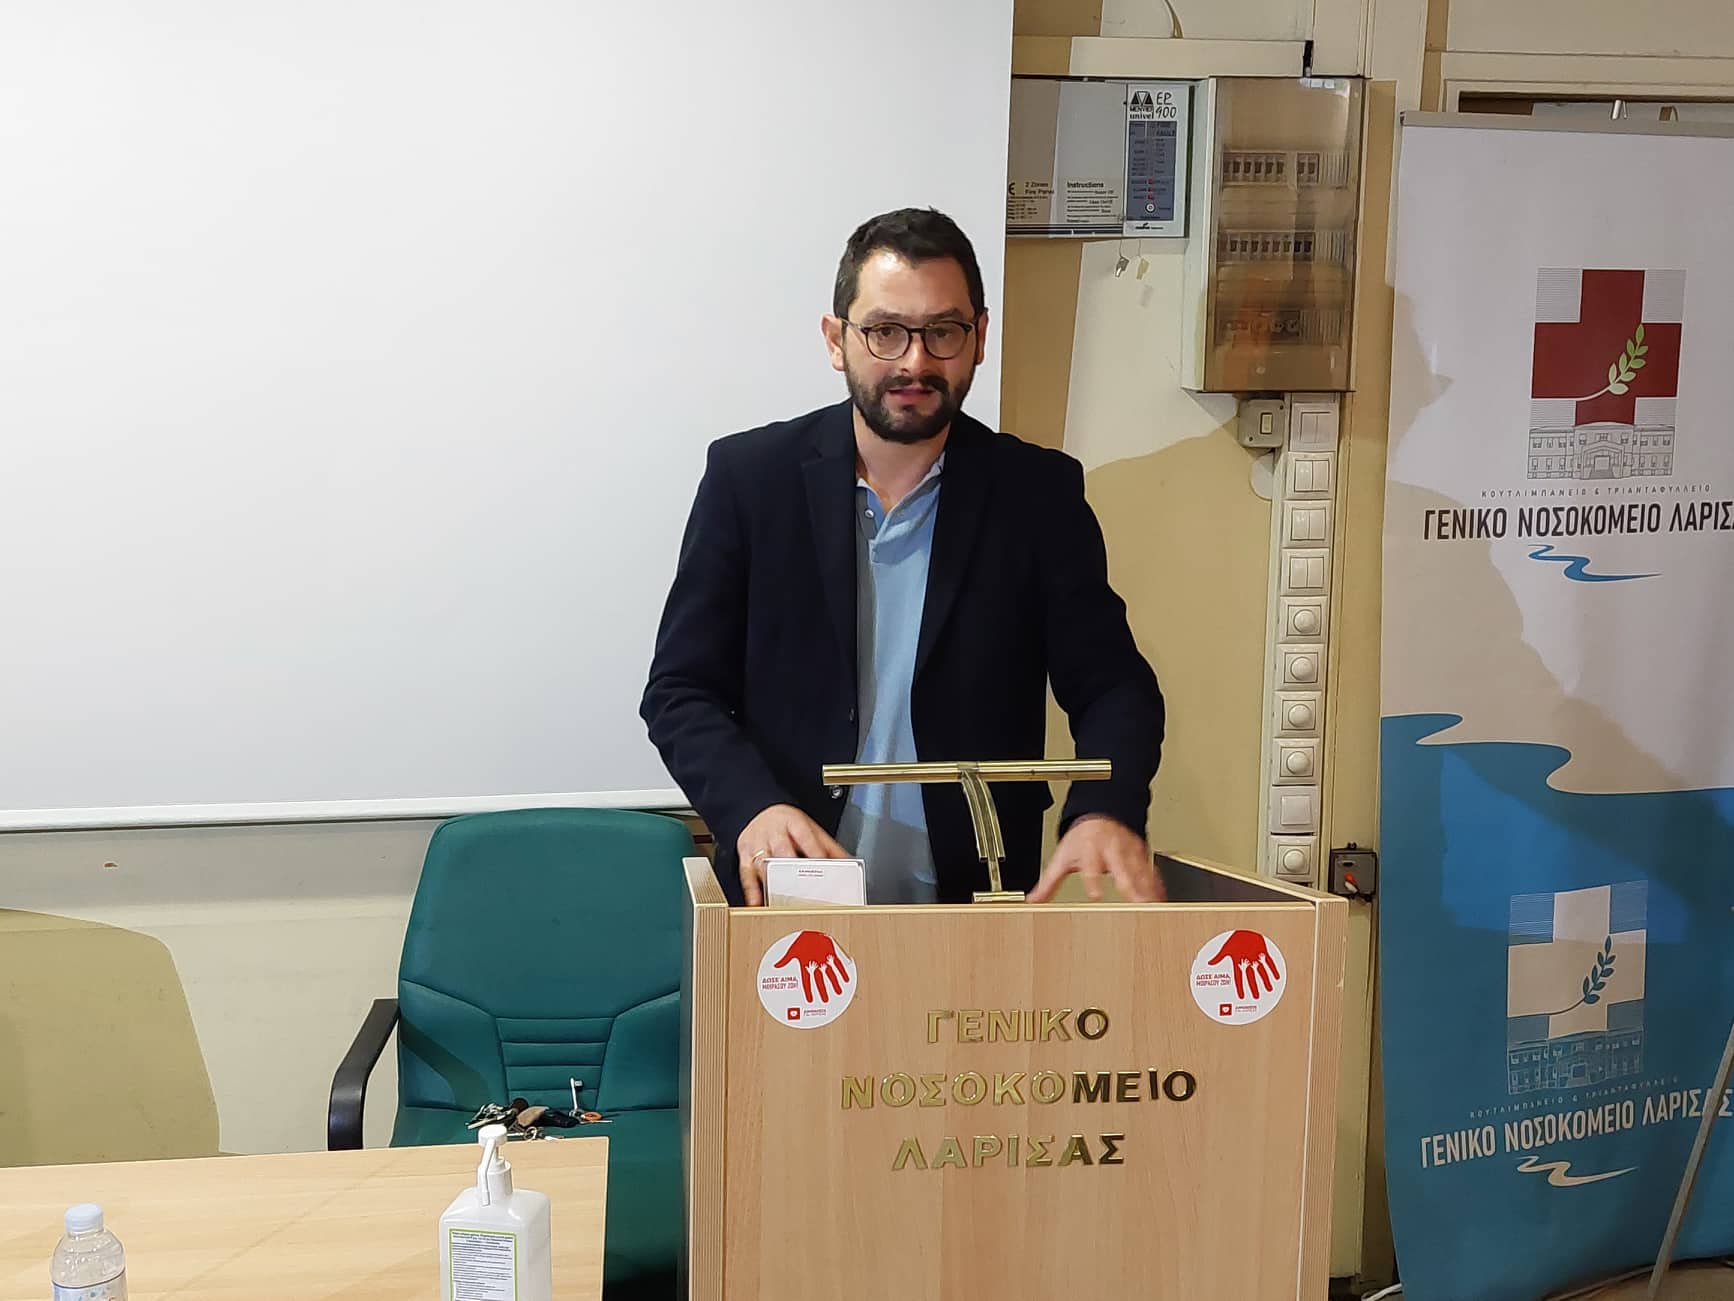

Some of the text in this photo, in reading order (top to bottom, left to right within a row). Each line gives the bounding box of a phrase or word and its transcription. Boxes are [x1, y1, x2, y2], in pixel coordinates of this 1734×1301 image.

[1423, 501, 1734, 540] ΓΕΝΙΚΟ ΝΟΣΟΚΟΜΕΙΟ ΛΑΡΙΣ
[927, 1007, 1109, 1044] ΓΕΝΙΚΟ
[841, 1067, 1196, 1109] ΝΟΣΟΚΟΜΕΙΟ
[892, 1133, 1125, 1170] ΛΑΡΙΣΑΣ
[1420, 1125, 1496, 1168] ΓΕΝΙΚΟ
[1504, 1100, 1634, 1152] ΝΟΣΟΚΟΜΕΙΟ
